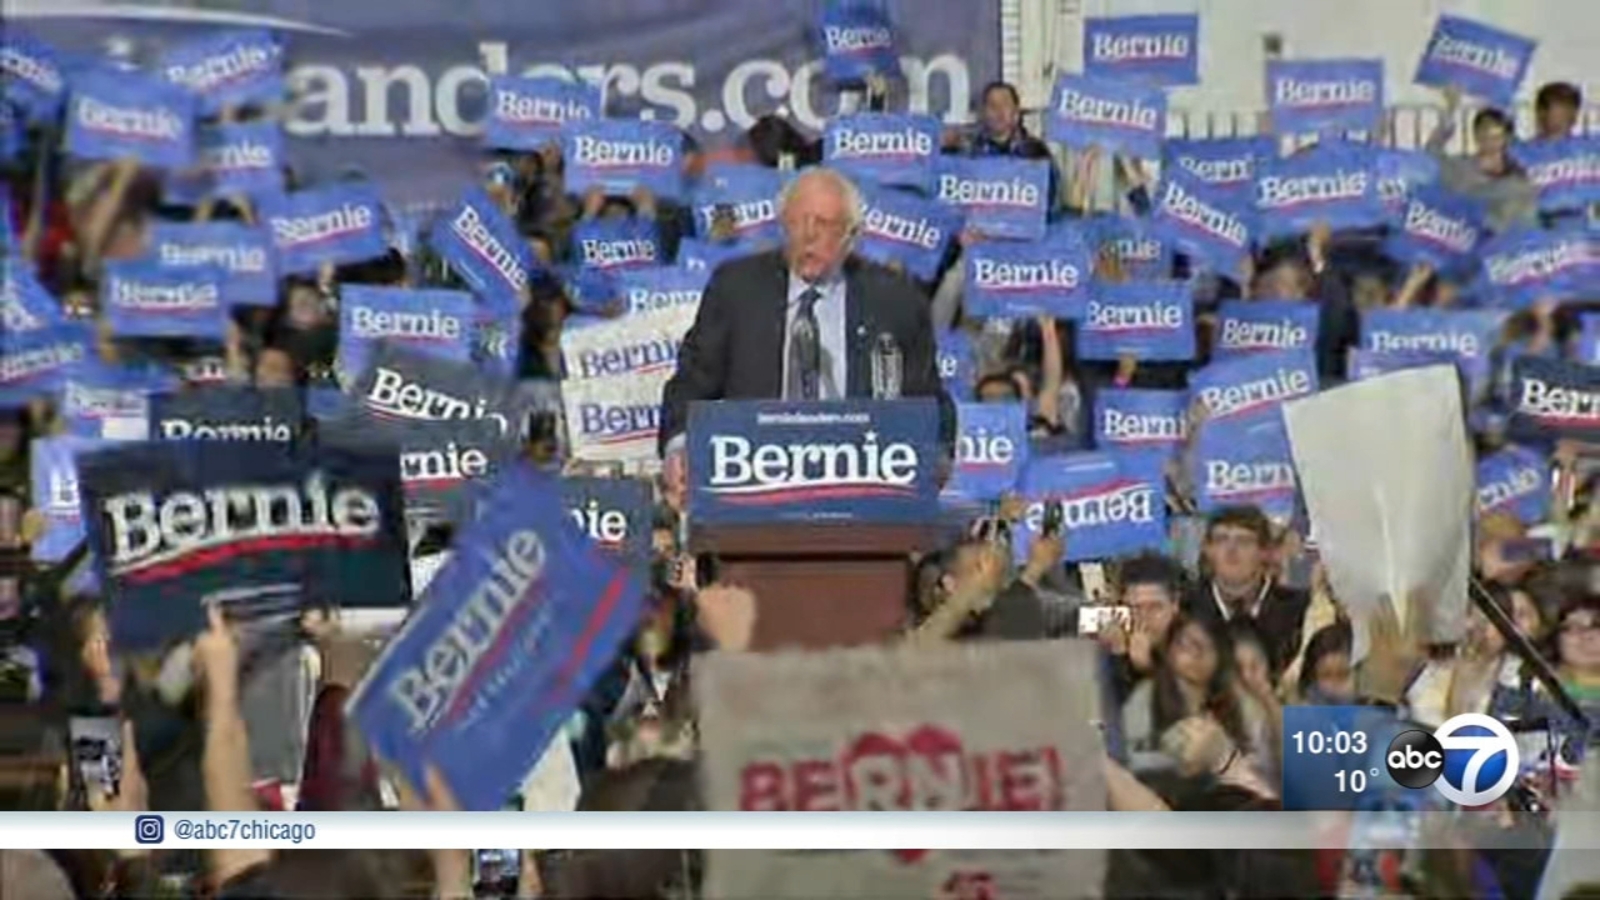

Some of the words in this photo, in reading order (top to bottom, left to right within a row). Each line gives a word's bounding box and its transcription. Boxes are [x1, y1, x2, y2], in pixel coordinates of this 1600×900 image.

[824, 24, 892, 50] Bernie
[1092, 32, 1189, 59] Bernie
[1275, 78, 1375, 103] Bernie
[1058, 88, 1157, 130] Bernie
[220, 141, 271, 168] nie
[574, 135, 673, 166] Bernie
[833, 128, 933, 156] Bernie
[938, 174, 1040, 207] Bernie
[1258, 169, 1367, 205] Bernie
[272, 203, 372, 242] Bernie
[1164, 180, 1248, 248] Bernie
[452, 204, 529, 291] Bernie
[582, 238, 656, 264] Bernie
[974, 257, 1079, 288] Bernie
[352, 306, 461, 339] Bernie
[1086, 300, 1182, 330] Bernie
[1222, 318, 1307, 349] Bernie
[1370, 330, 1479, 356] Bernie
[1202, 368, 1310, 411] Bernie
[400, 442, 488, 478] rnie
[709, 430, 918, 485] Bernie
[956, 428, 1014, 465] nie
[103, 470, 381, 565] Bernie
[1026, 485, 1154, 531] Berne
[392, 529, 547, 735] Bernie
